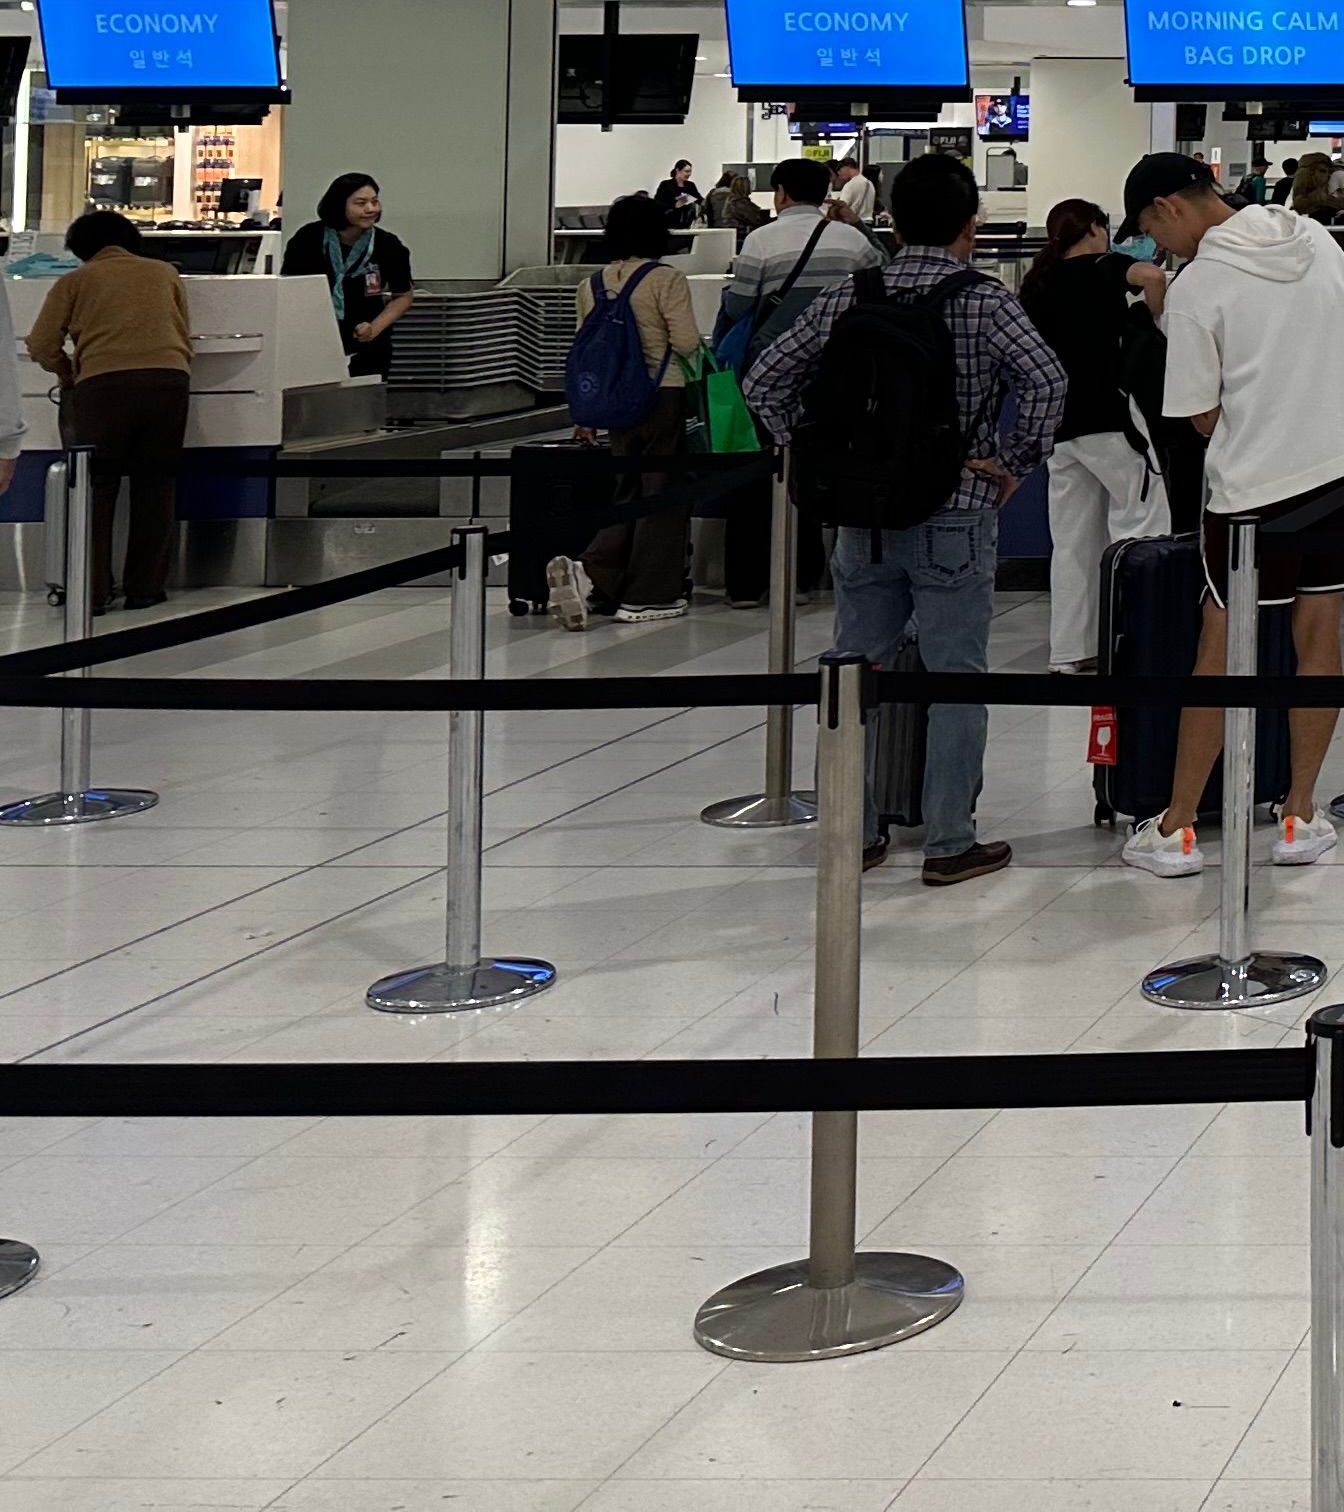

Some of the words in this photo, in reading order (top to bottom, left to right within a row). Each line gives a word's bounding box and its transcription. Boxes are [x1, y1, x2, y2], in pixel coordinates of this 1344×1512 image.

[95, 13, 219, 34] ECONOMY
[784, 12, 910, 32] ECONOMY
[1148, 11, 1264, 31] MORNING
[1272, 11, 1339, 31] CALM
[1184, 46, 1234, 66] BAG
[1242, 46, 1307, 65] DROP
